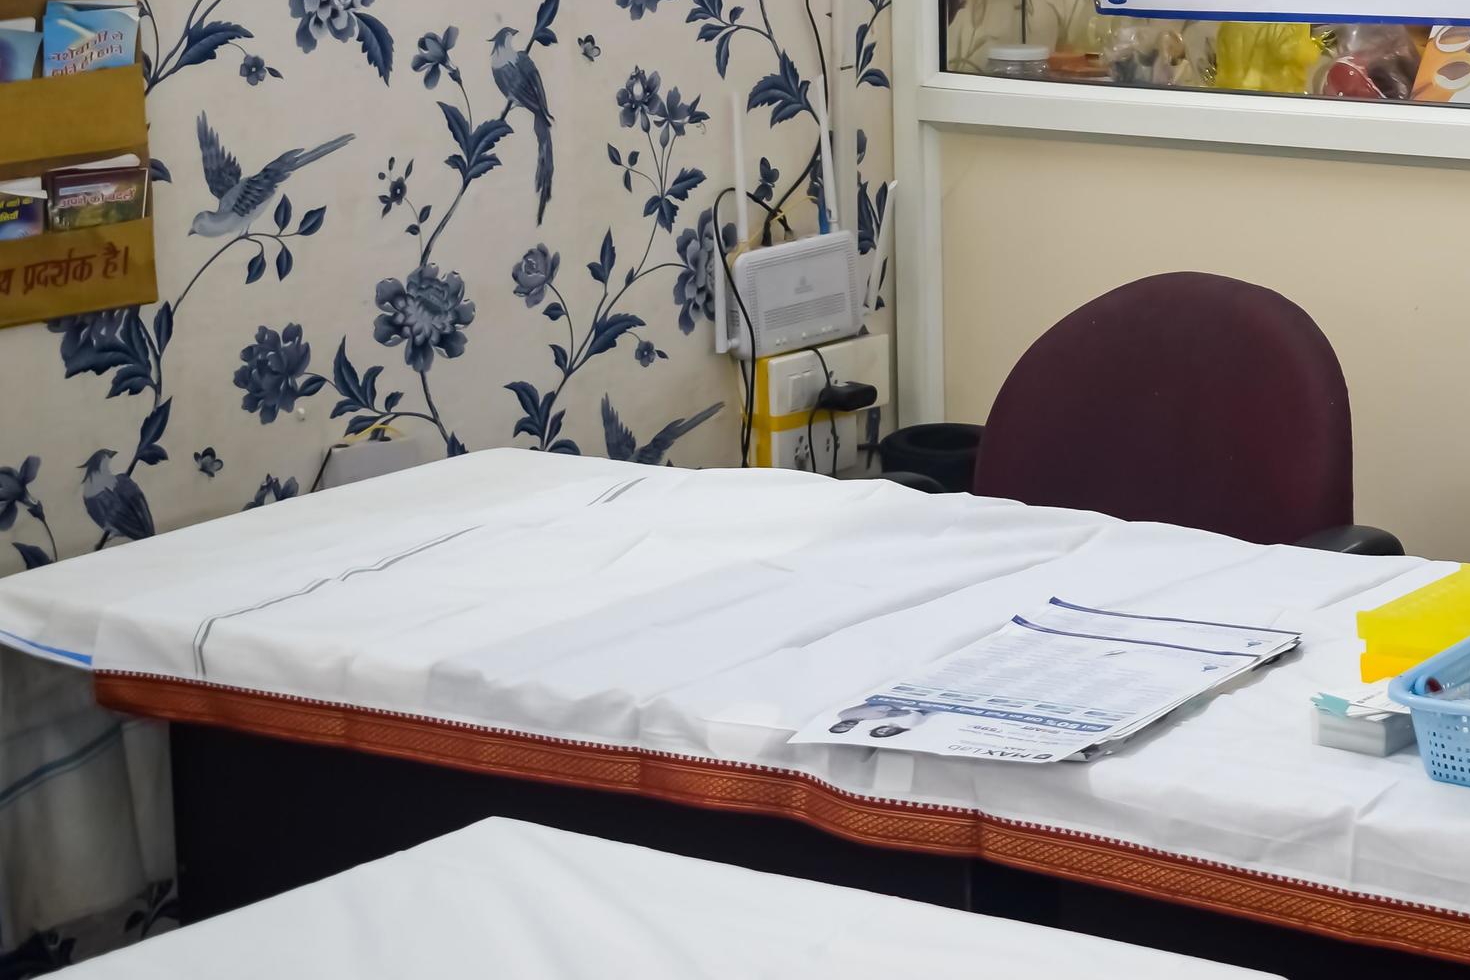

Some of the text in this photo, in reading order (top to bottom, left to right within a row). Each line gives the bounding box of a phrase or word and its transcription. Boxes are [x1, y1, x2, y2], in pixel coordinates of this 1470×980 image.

[1046, 719, 1078, 729] 50%
[948, 744, 979, 754] Lab
[983, 749, 1030, 759] MAX
